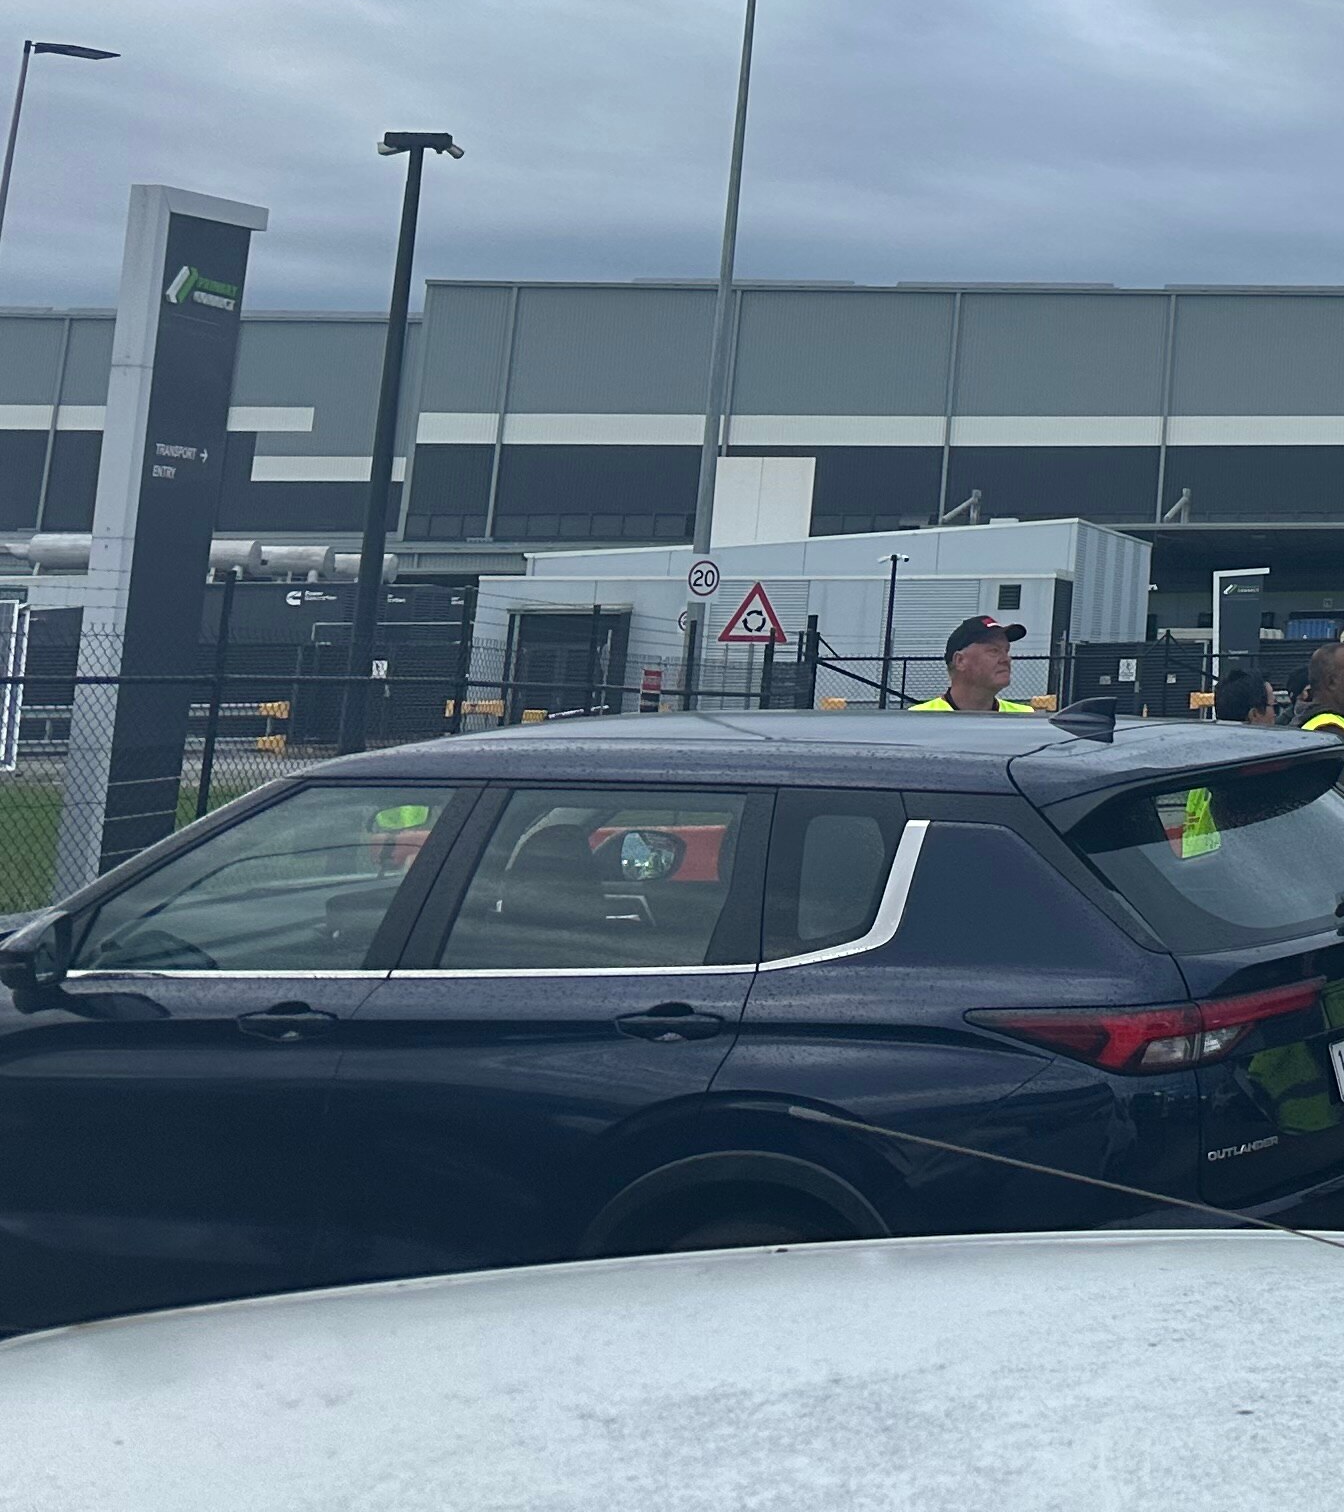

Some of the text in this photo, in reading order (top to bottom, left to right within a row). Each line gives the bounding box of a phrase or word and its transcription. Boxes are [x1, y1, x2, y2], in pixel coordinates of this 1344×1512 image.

[156, 442, 197, 460] TRANSPORT
[152, 464, 177, 479] ENTRY
[692, 569, 716, 588] 20
[1207, 1135, 1279, 1162] OUTLANDER
